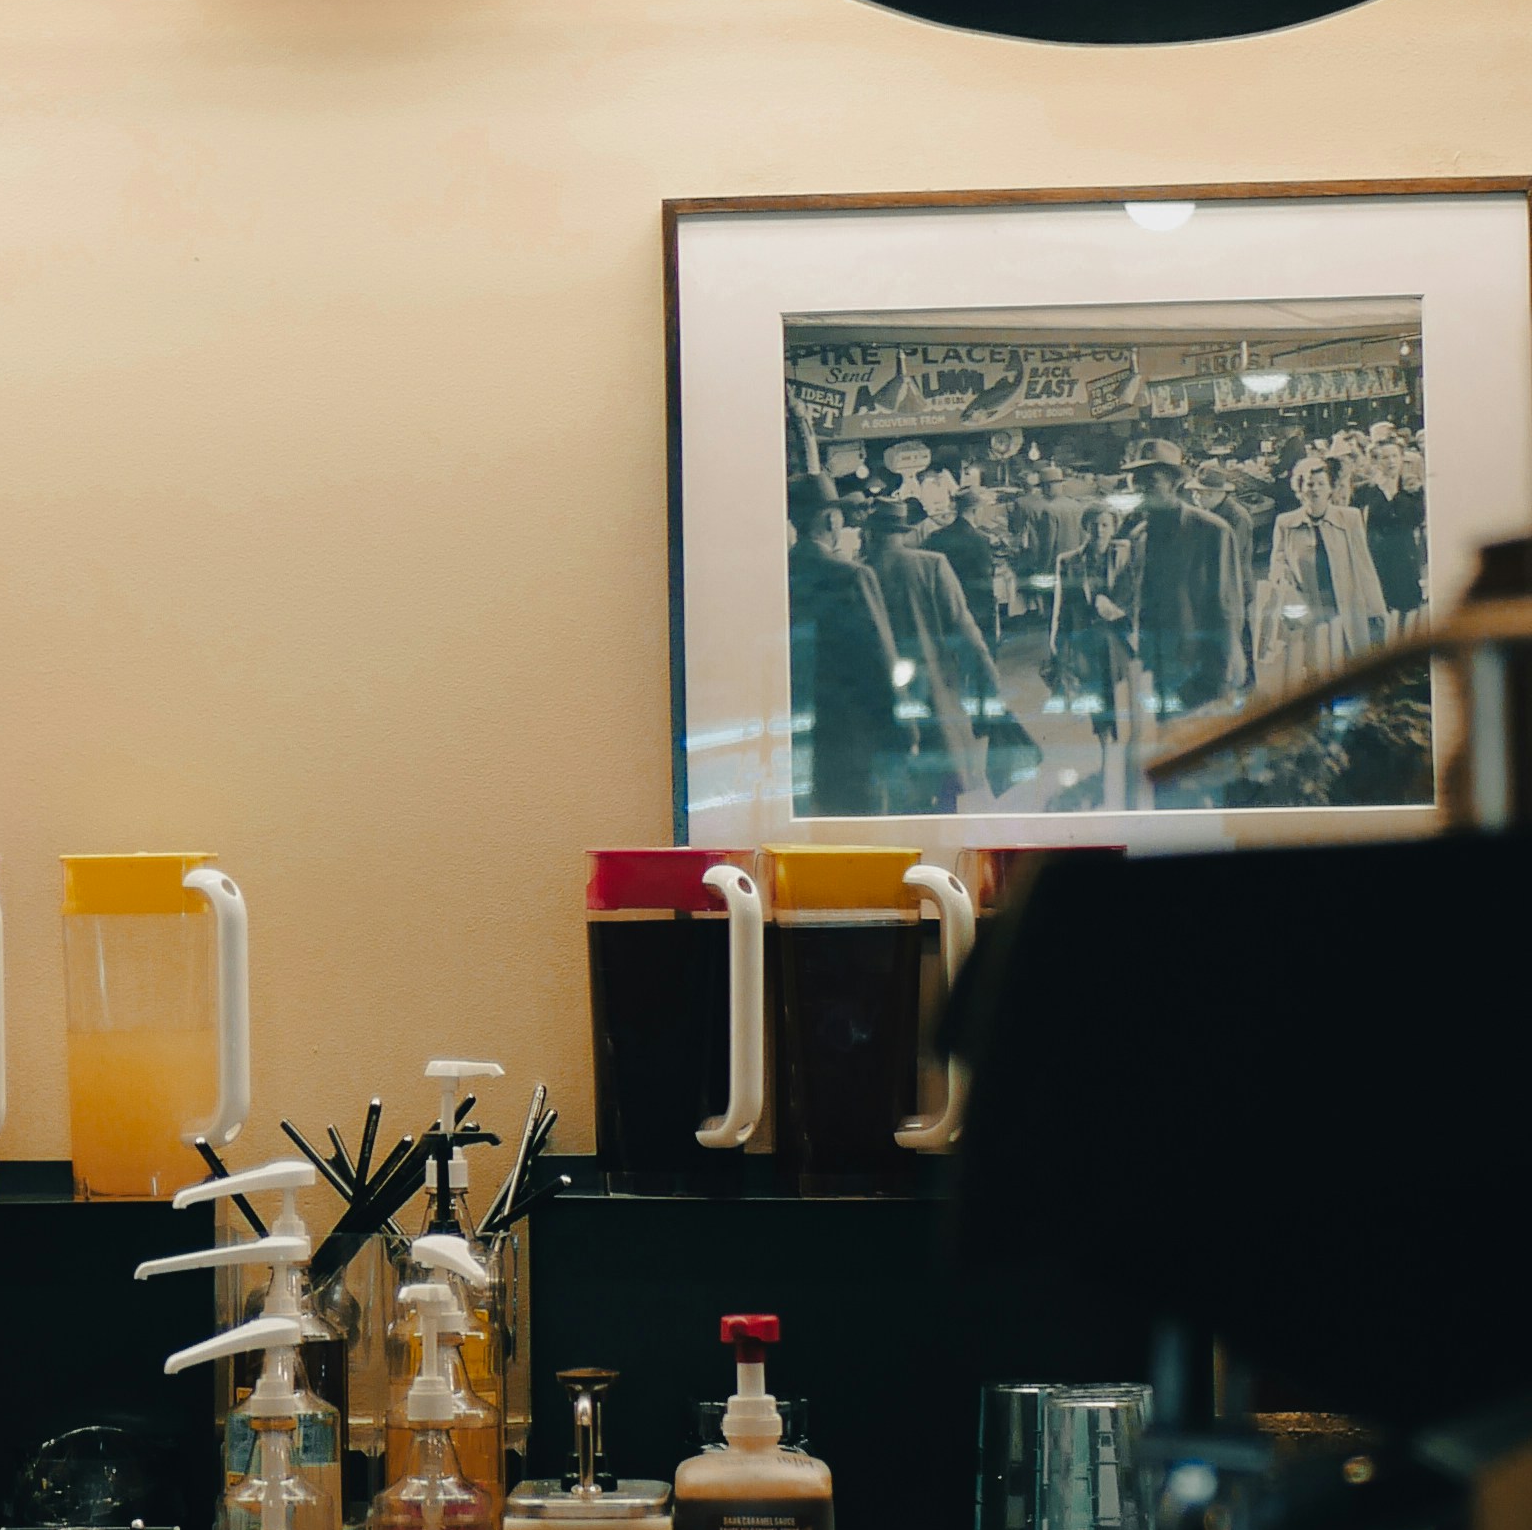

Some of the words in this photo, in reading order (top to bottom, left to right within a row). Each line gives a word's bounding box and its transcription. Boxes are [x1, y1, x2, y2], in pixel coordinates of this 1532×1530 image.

[826, 368, 874, 384] Send
[801, 387, 843, 408] IDEAL
[1025, 379, 1080, 400] EAST
